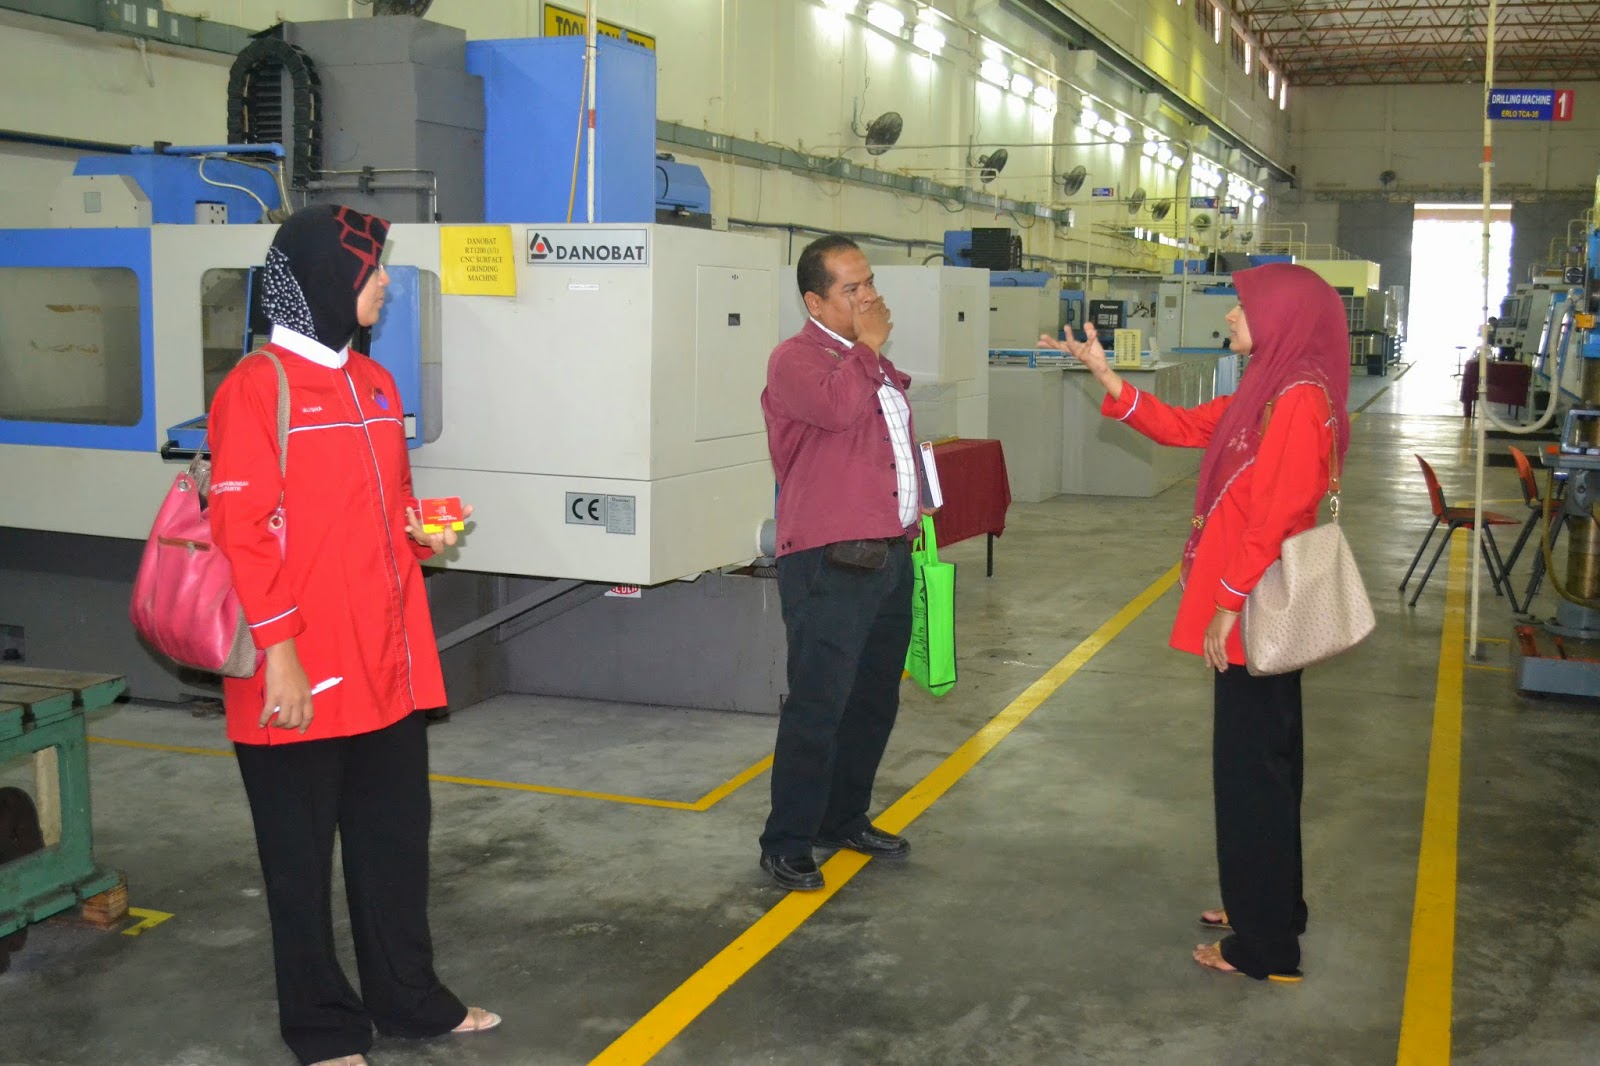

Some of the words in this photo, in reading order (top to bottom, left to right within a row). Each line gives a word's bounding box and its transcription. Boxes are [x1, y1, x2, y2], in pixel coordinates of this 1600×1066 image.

[1492, 94, 1520, 104] DRILLING
[1522, 95, 1551, 105] MACHINE
[1558, 92, 1566, 118] 1
[556, 245, 644, 260] DANOBAT
[572, 498, 599, 521] CE
